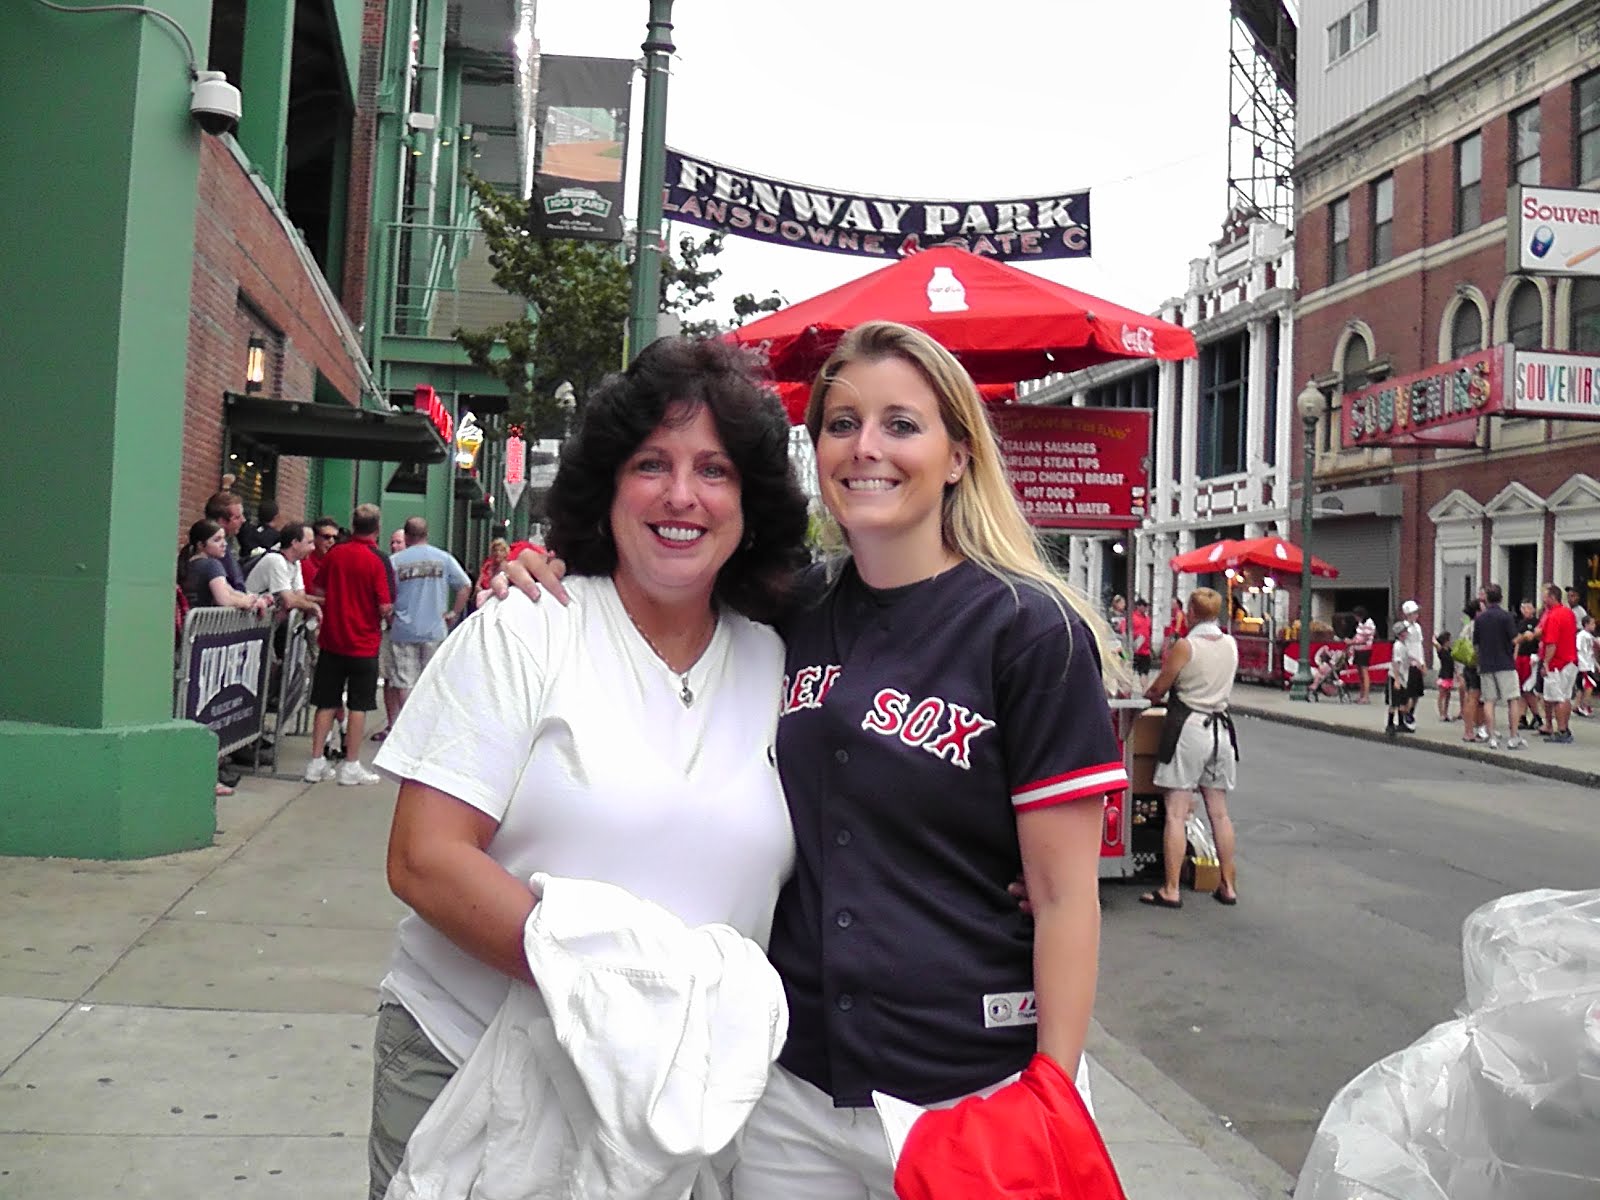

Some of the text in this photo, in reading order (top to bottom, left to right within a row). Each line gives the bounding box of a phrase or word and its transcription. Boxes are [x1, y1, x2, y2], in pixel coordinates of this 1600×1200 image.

[677, 158, 1077, 236] FENWAY PARK
[662, 188, 885, 254] LANSDOWNE
[1062, 226, 1088, 251] C
[1517, 362, 1600, 405] SOUVENIRS
[1350, 361, 1491, 439] SOUVENIRS
[1044, 441, 1097, 454] SAUSAGES
[1044, 456, 1076, 468] STEAK
[1078, 457, 1100, 470] TIPS
[1038, 471, 1084, 484] CHICKEN
[1085, 472, 1125, 485] BREAST
[1024, 486, 1076, 499] HOT DOGS
[1035, 501, 1063, 513] SODA
[1065, 501, 1075, 514] &
[1075, 502, 1112, 514] WATER
[861, 687, 997, 770] SOX
